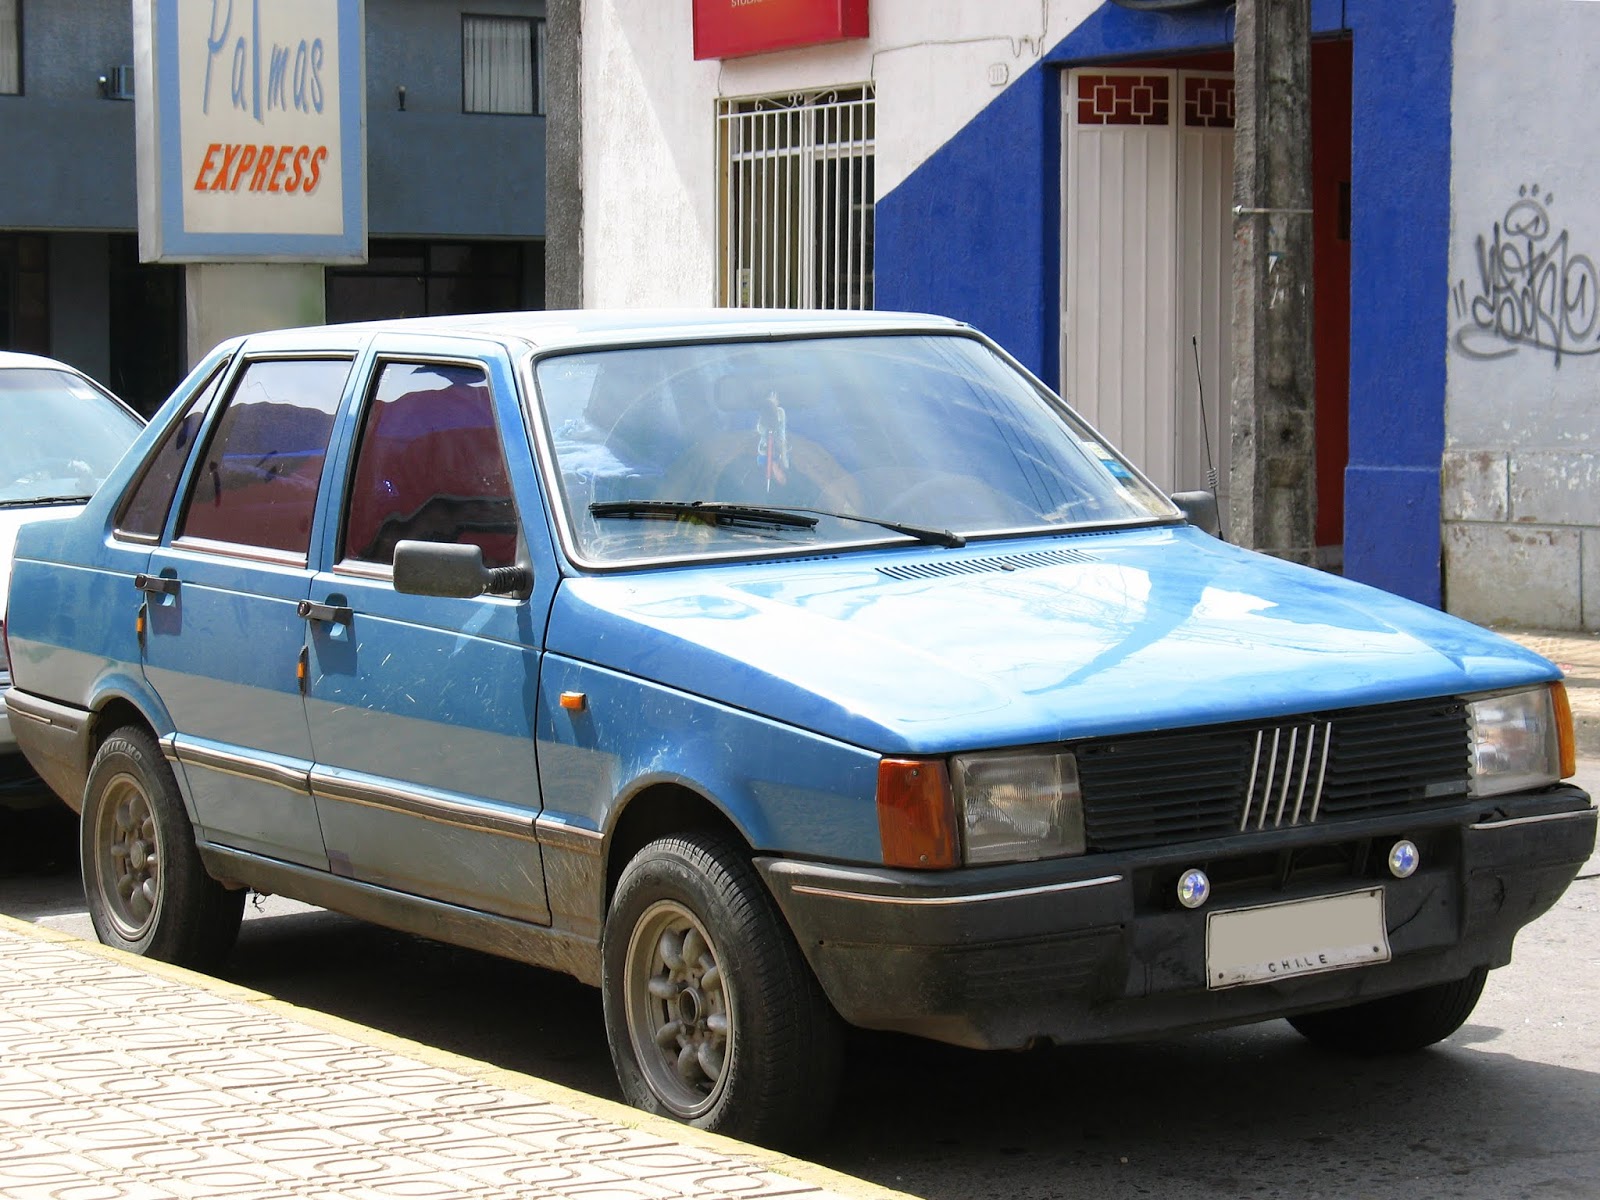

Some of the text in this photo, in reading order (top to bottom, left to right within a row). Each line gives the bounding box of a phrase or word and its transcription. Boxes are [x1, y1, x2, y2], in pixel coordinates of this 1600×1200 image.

[203, 0, 324, 124] Palmas
[194, 143, 327, 193] EXPRESS
[1268, 954, 1329, 973] CHILE
